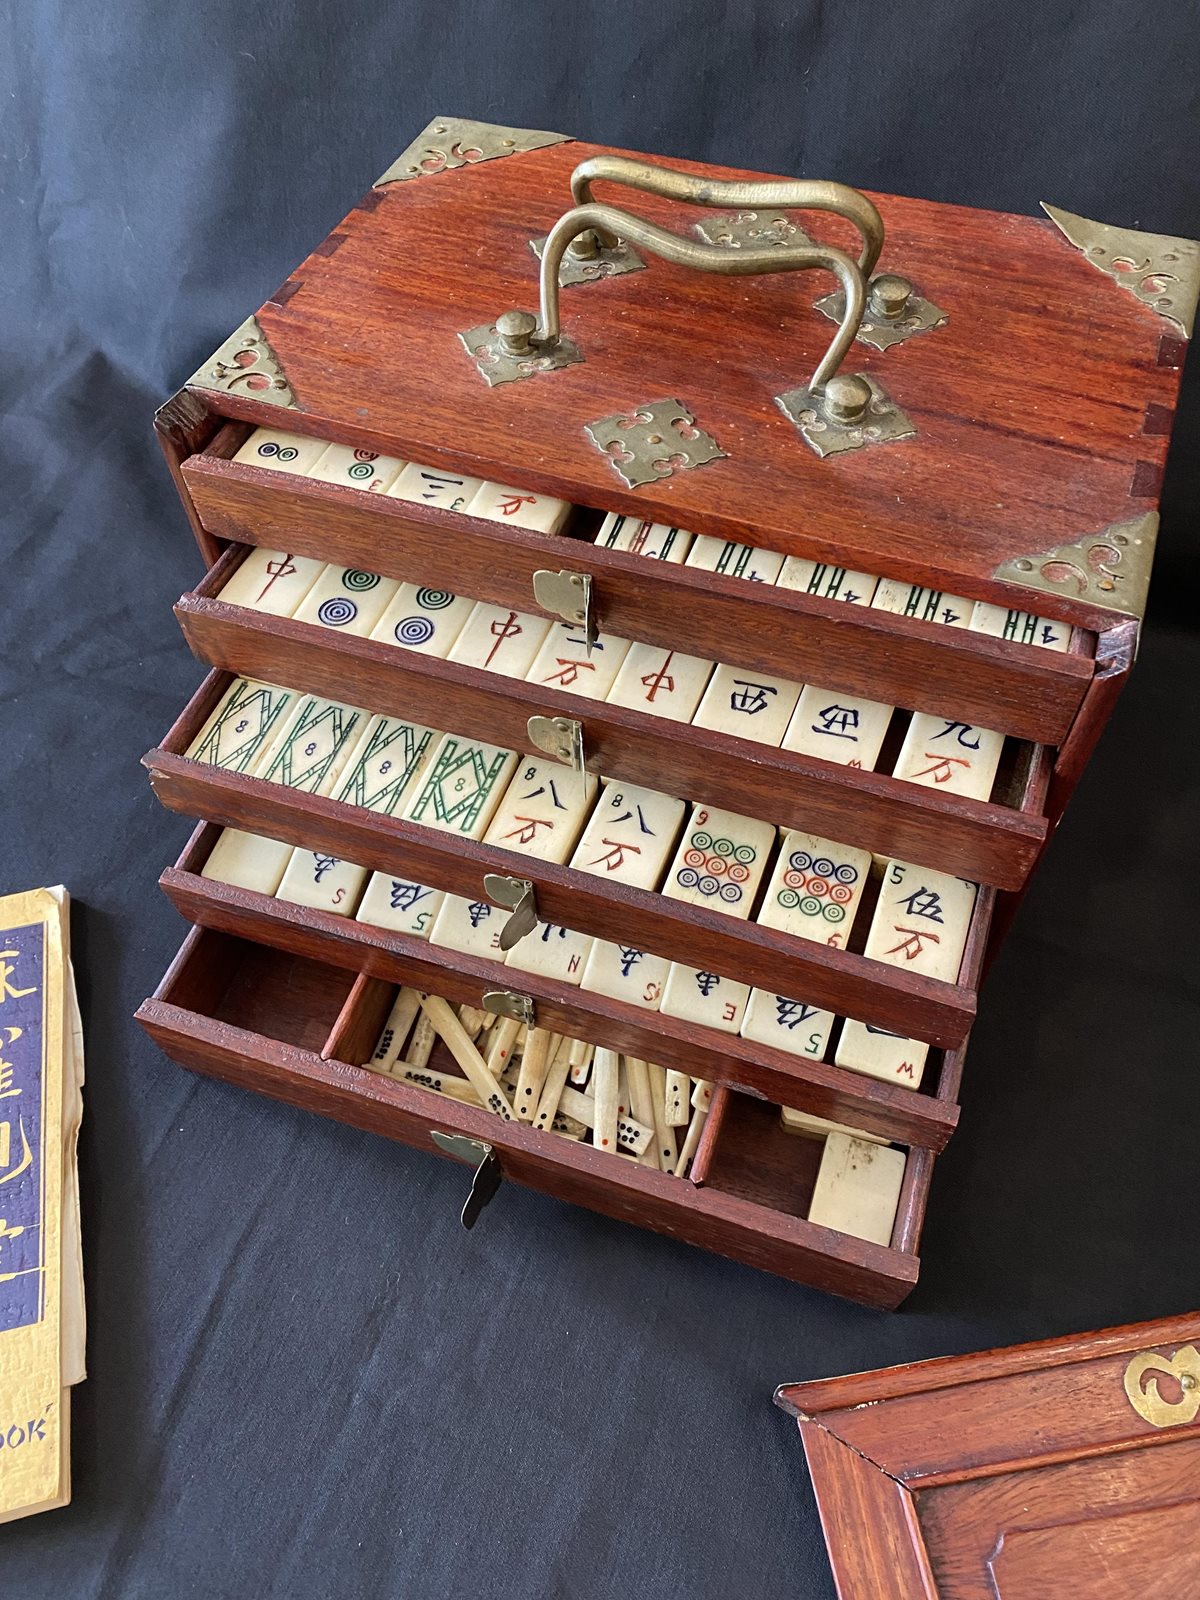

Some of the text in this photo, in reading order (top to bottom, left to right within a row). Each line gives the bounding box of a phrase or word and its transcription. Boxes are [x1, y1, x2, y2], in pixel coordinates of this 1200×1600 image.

[450, 497, 465, 511] 3
[254, 553, 297, 604] 中
[941, 608, 961, 624] 4
[484, 611, 523, 668] 中
[1041, 625, 1060, 644] 4
[640, 650, 675, 703] 中
[730, 679, 778, 715] 西
[235, 719, 249, 734] 8
[811, 704, 860, 742] 西
[304, 742, 318, 756] 8
[378, 760, 393, 775] 8
[524, 767, 537, 781] 8
[454, 777, 466, 792] 8
[611, 793, 624, 808] 8
[695, 810, 709, 827] 9
[889, 865, 907, 885] 5
[331, 887, 346, 905] S
[567, 953, 582, 973] N
[643, 981, 660, 1002] S
[722, 1002, 737, 1022] E
[896, 1061, 915, 1079] W
